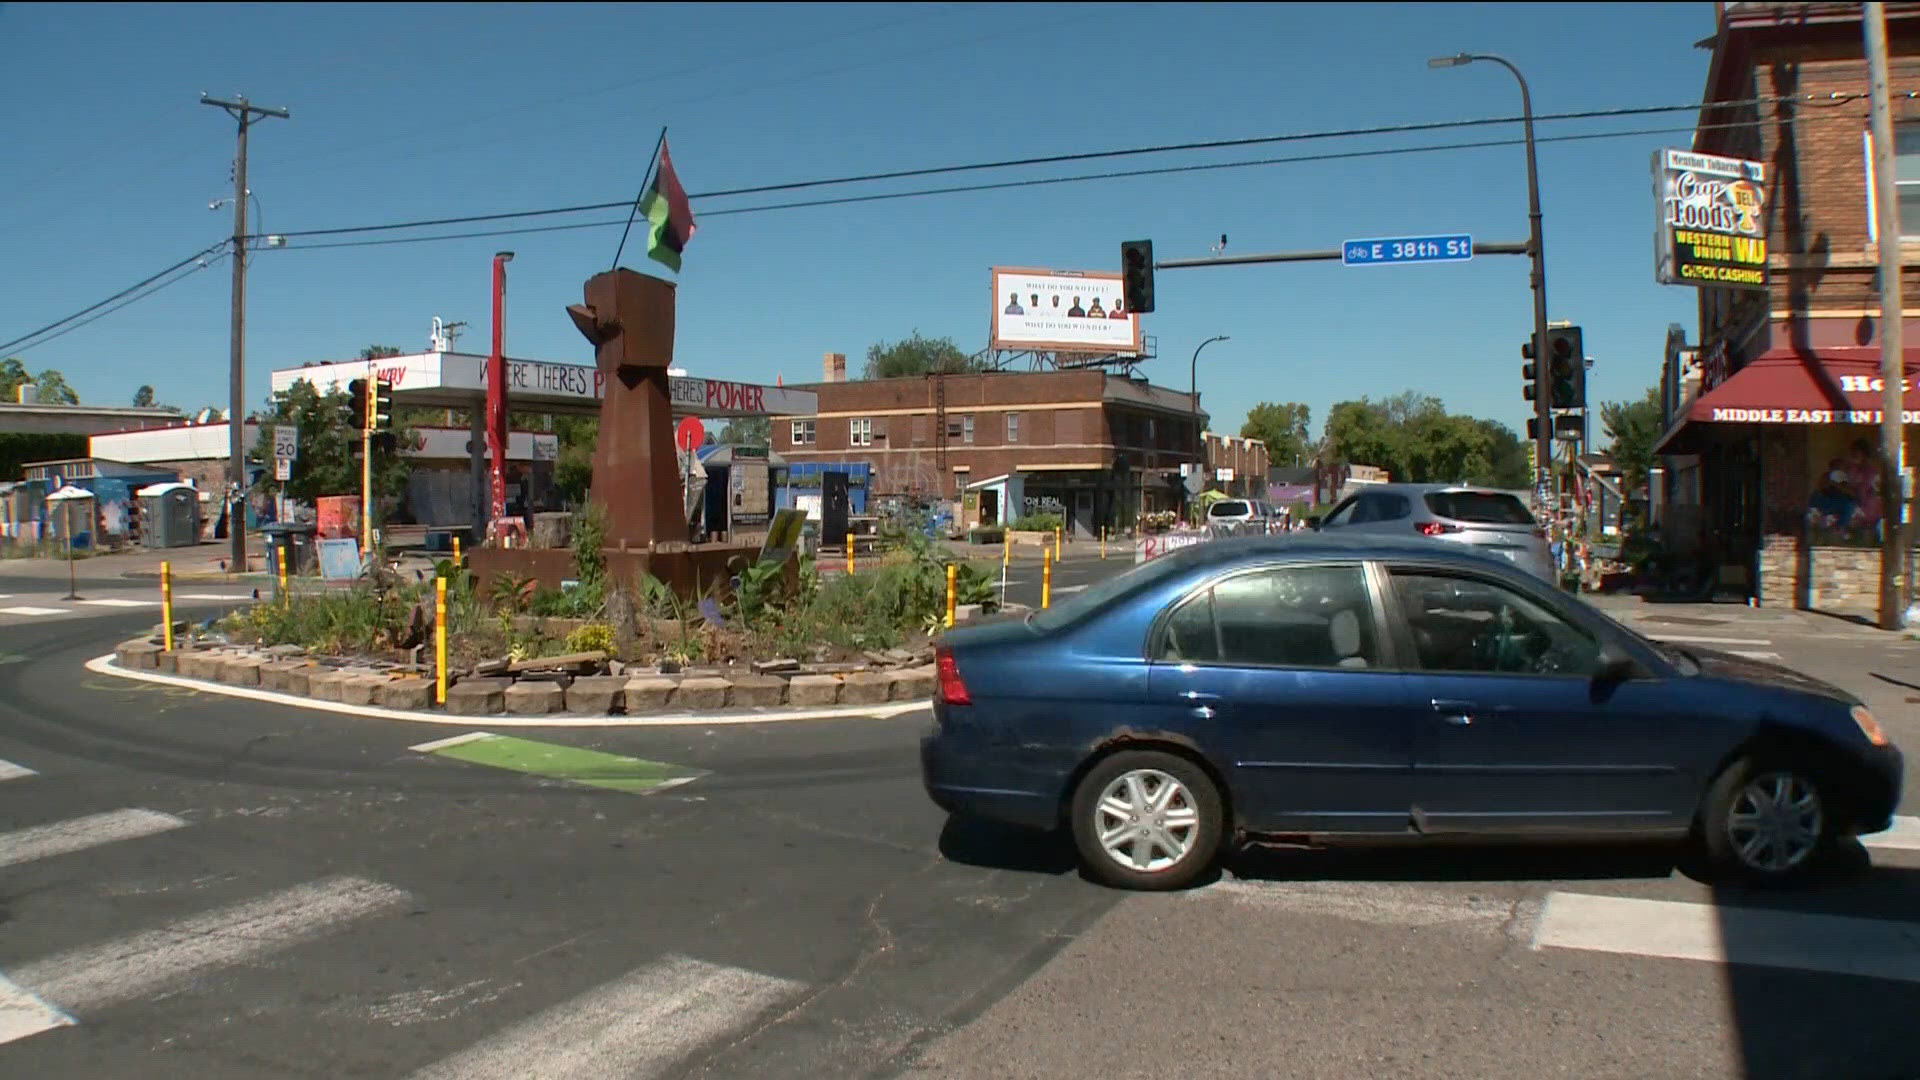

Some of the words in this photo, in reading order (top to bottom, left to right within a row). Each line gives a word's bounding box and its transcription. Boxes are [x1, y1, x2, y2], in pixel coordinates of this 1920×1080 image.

[1677, 171, 1723, 206] Cup
[1671, 198, 1733, 230] Foods
[1676, 231, 1731, 248] WESTERN
[1371, 244, 1384, 259] E
[1391, 242, 1439, 258] 38th
[1446, 240, 1469, 256] St
[1693, 245, 1732, 260] UNION
[1681, 264, 1718, 280] CHECK
[1718, 266, 1764, 283] CASHING
[480, 360, 528, 388] WERE
[535, 363, 587, 394] THERES
[670, 380, 704, 403] HERES
[706, 379, 766, 413] POWER
[1713, 408, 1785, 423] MIDDLE
[1786, 409, 1873, 424] EASTERN
[276, 442, 296, 456] 20
